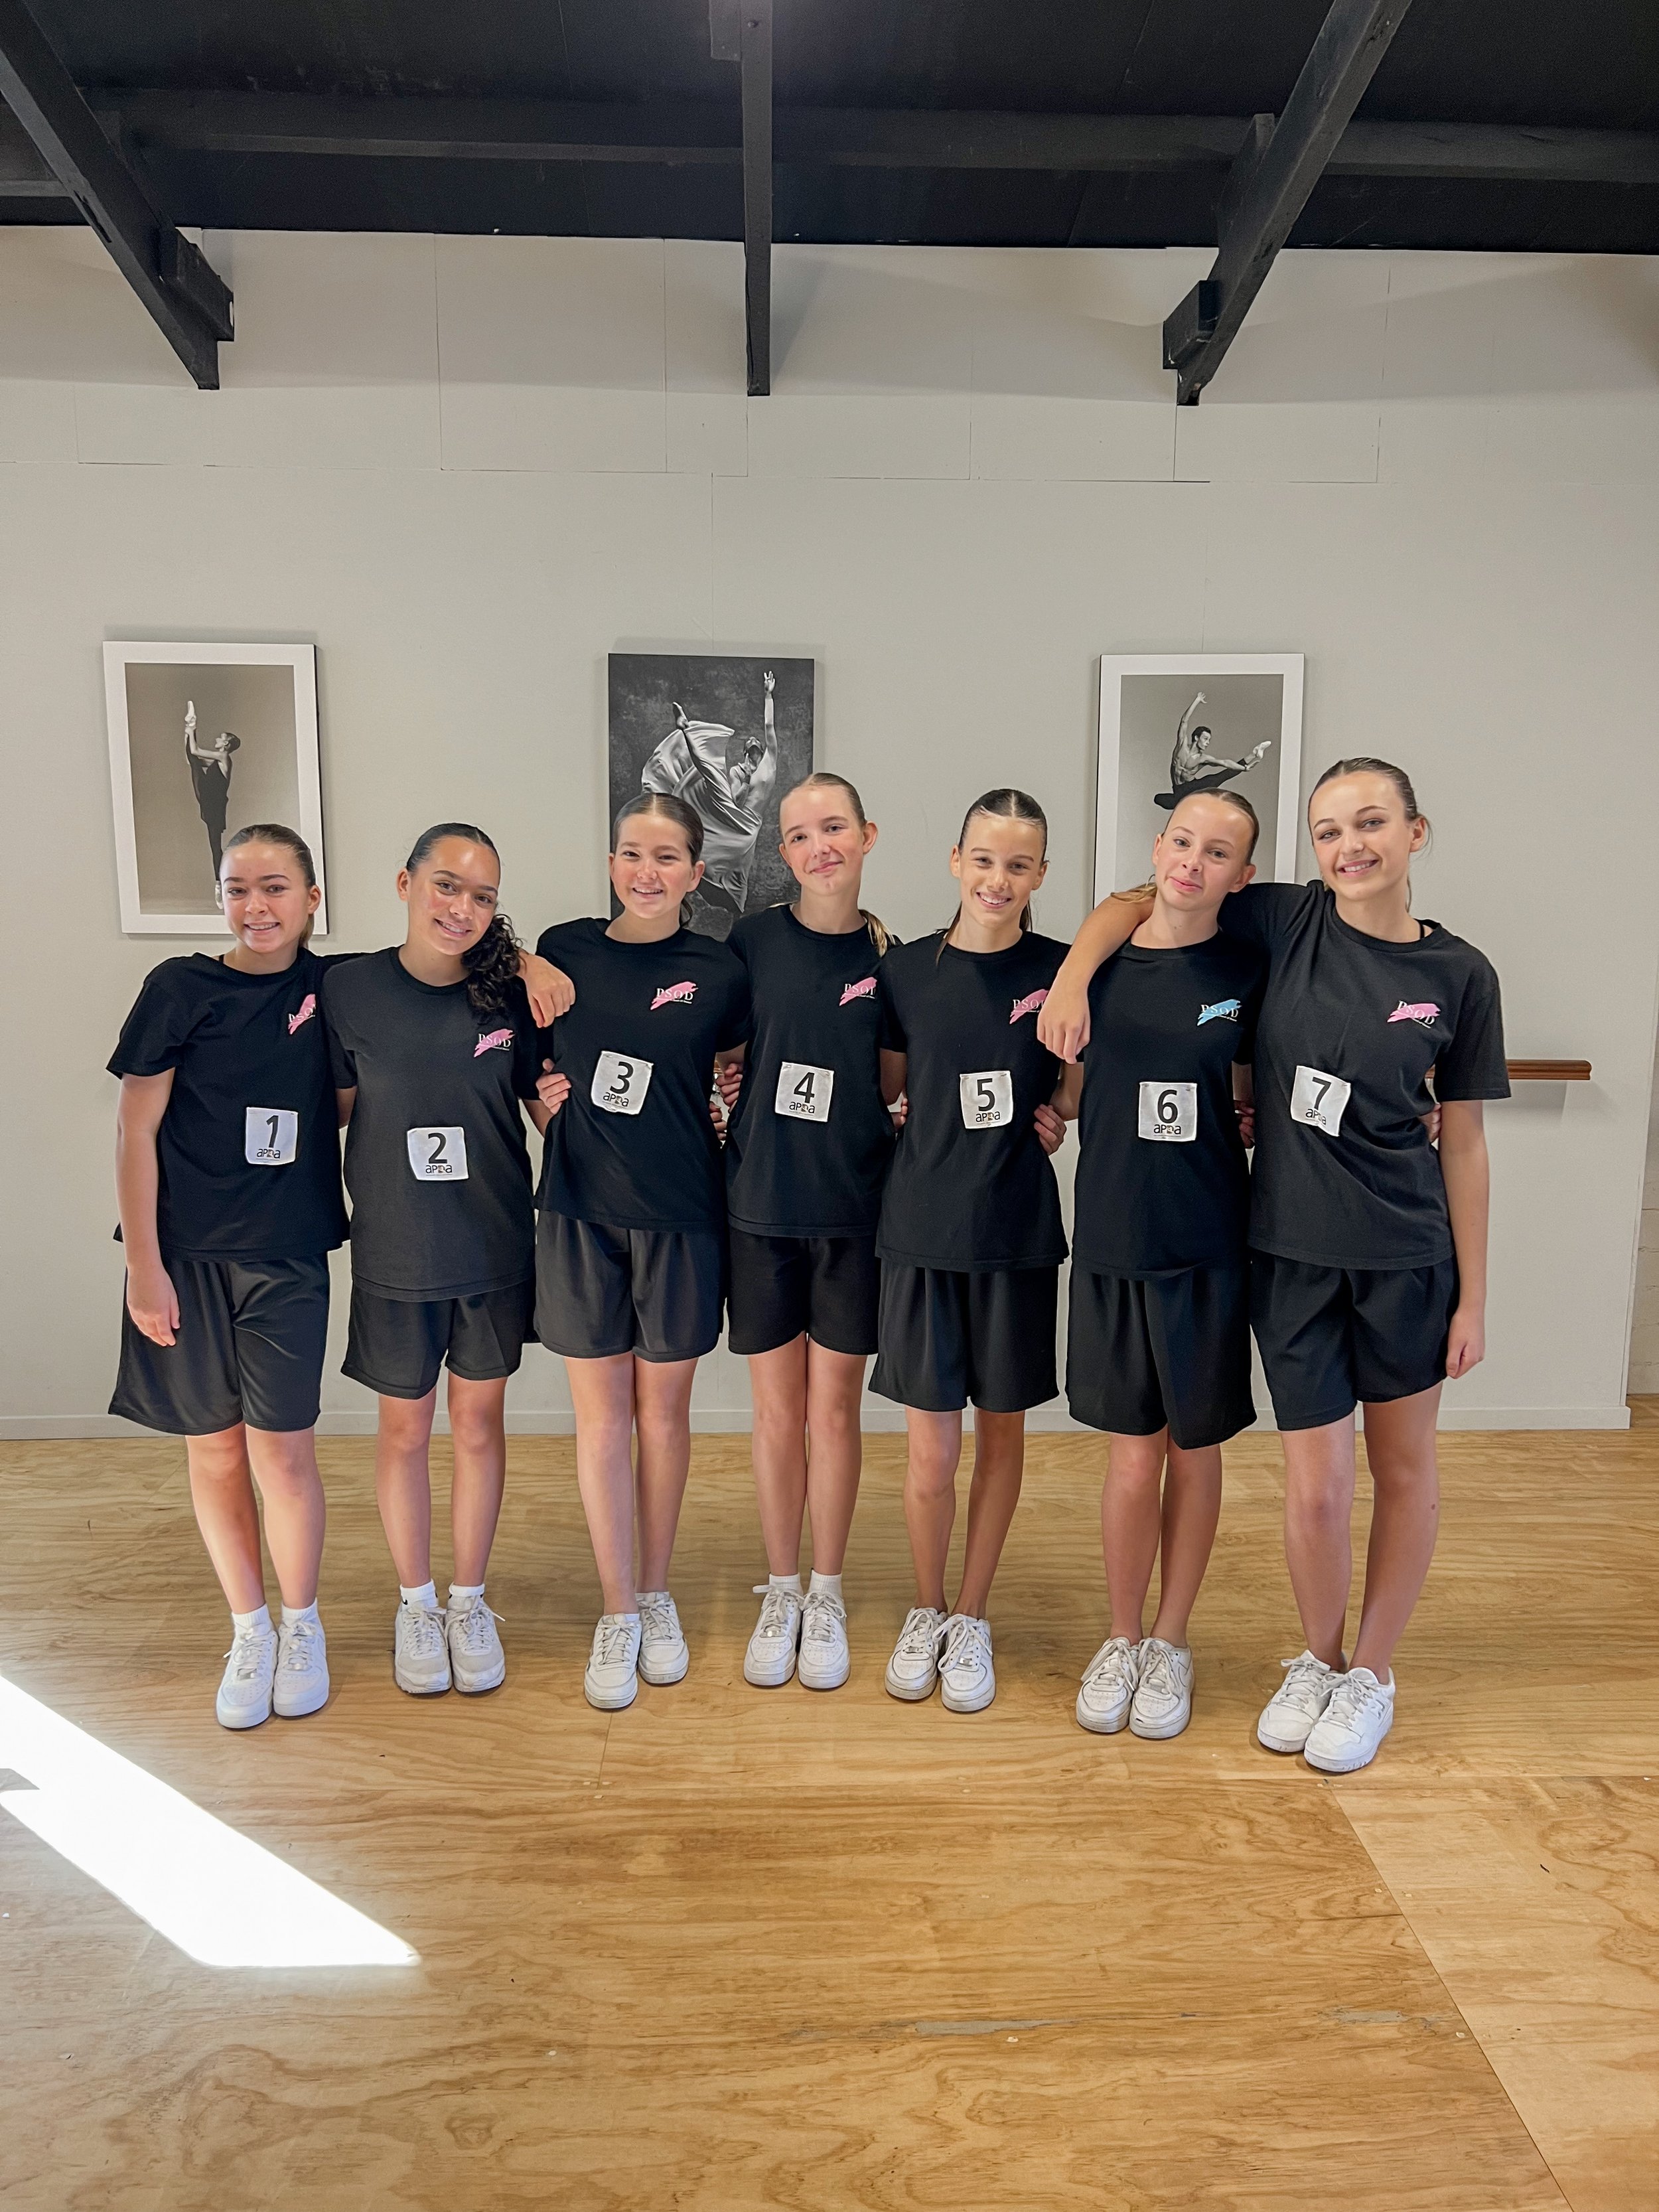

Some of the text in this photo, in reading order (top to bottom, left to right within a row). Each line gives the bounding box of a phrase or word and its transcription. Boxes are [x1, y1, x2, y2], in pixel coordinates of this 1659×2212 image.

[656, 988, 693, 1001] PSOD
[1200, 1004, 1239, 1018] PSOD
[609, 1061, 634, 1094] 3
[793, 1071, 815, 1103] 4
[1311, 1076, 1332, 1109] 7
[976, 1078, 995, 1112] 5
[1157, 1089, 1178, 1124] 6
[265, 1115, 279, 1148] 1
[427, 1132, 448, 1164] 2
